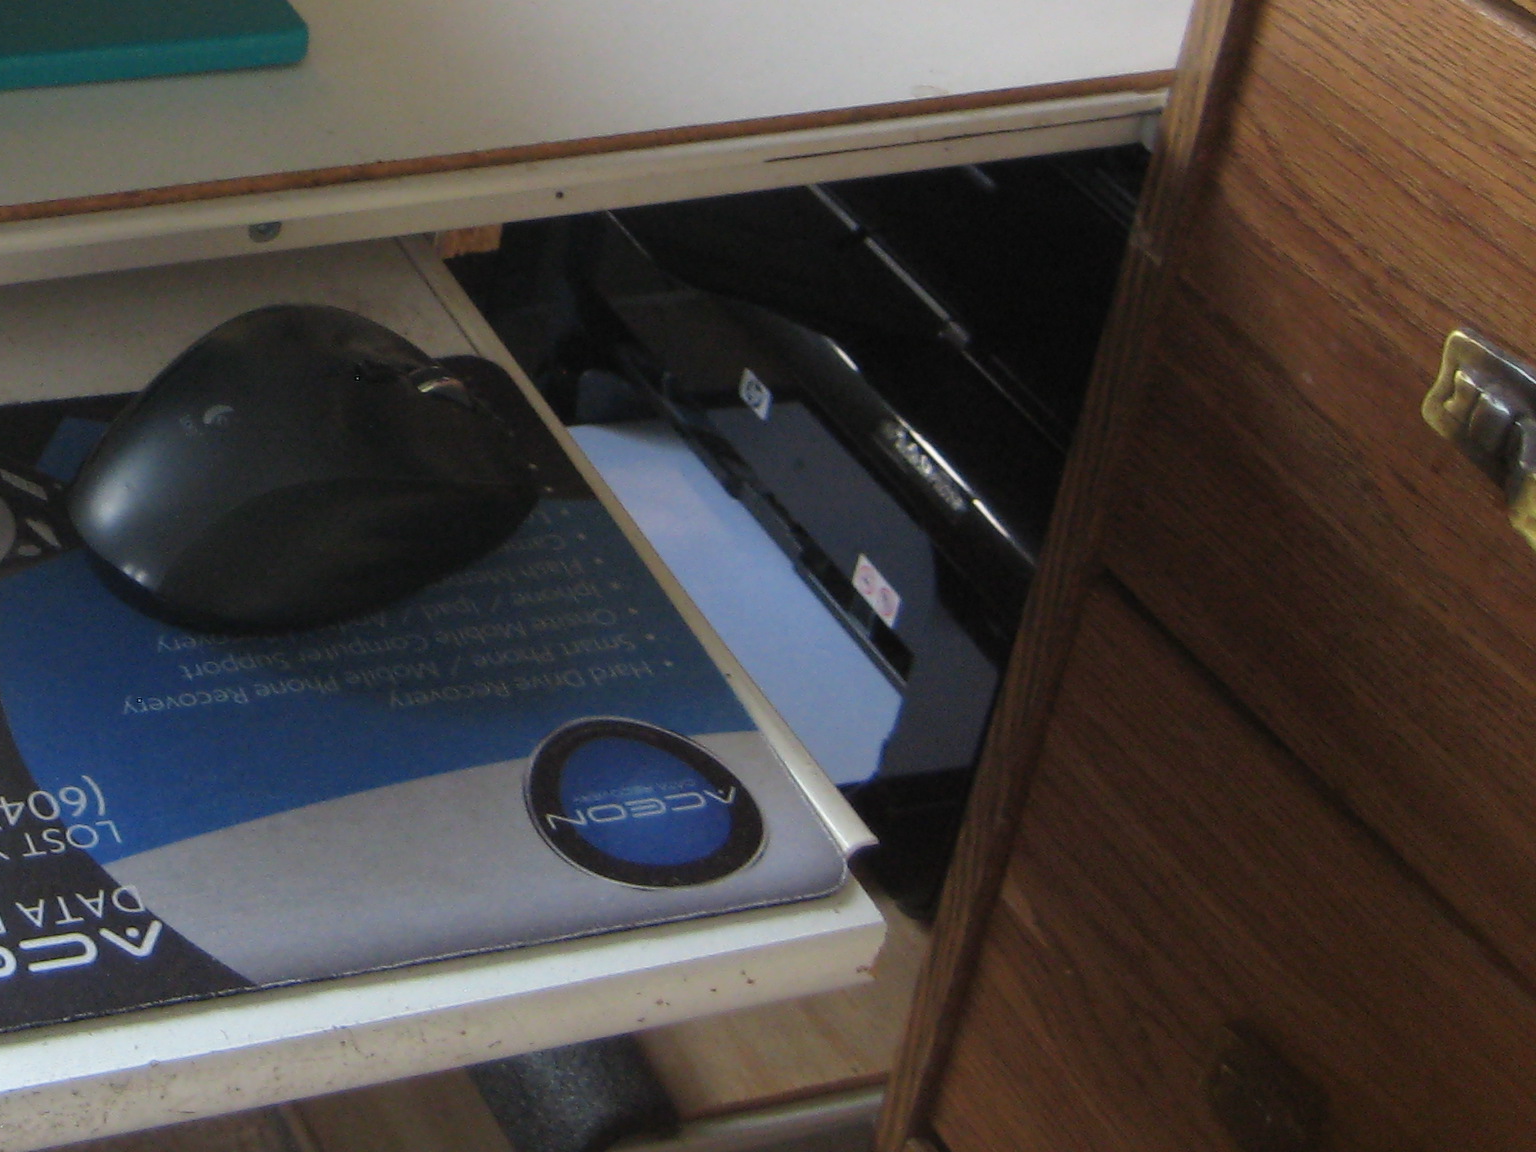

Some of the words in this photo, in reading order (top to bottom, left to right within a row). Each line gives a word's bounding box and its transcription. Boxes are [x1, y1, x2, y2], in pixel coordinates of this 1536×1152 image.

[178, 647, 286, 683] Support
[342, 658, 439, 691] Mobile
[514, 668, 588, 694] Drive
[589, 658, 656, 685] Hard
[120, 686, 250, 718] Recovery
[252, 672, 339, 702] Phone
[388, 680, 511, 711] Recovery
[544, 785, 737, 830] ACEON
[21, 820, 123, 858] LOST
[16, 885, 146, 929] DATA
